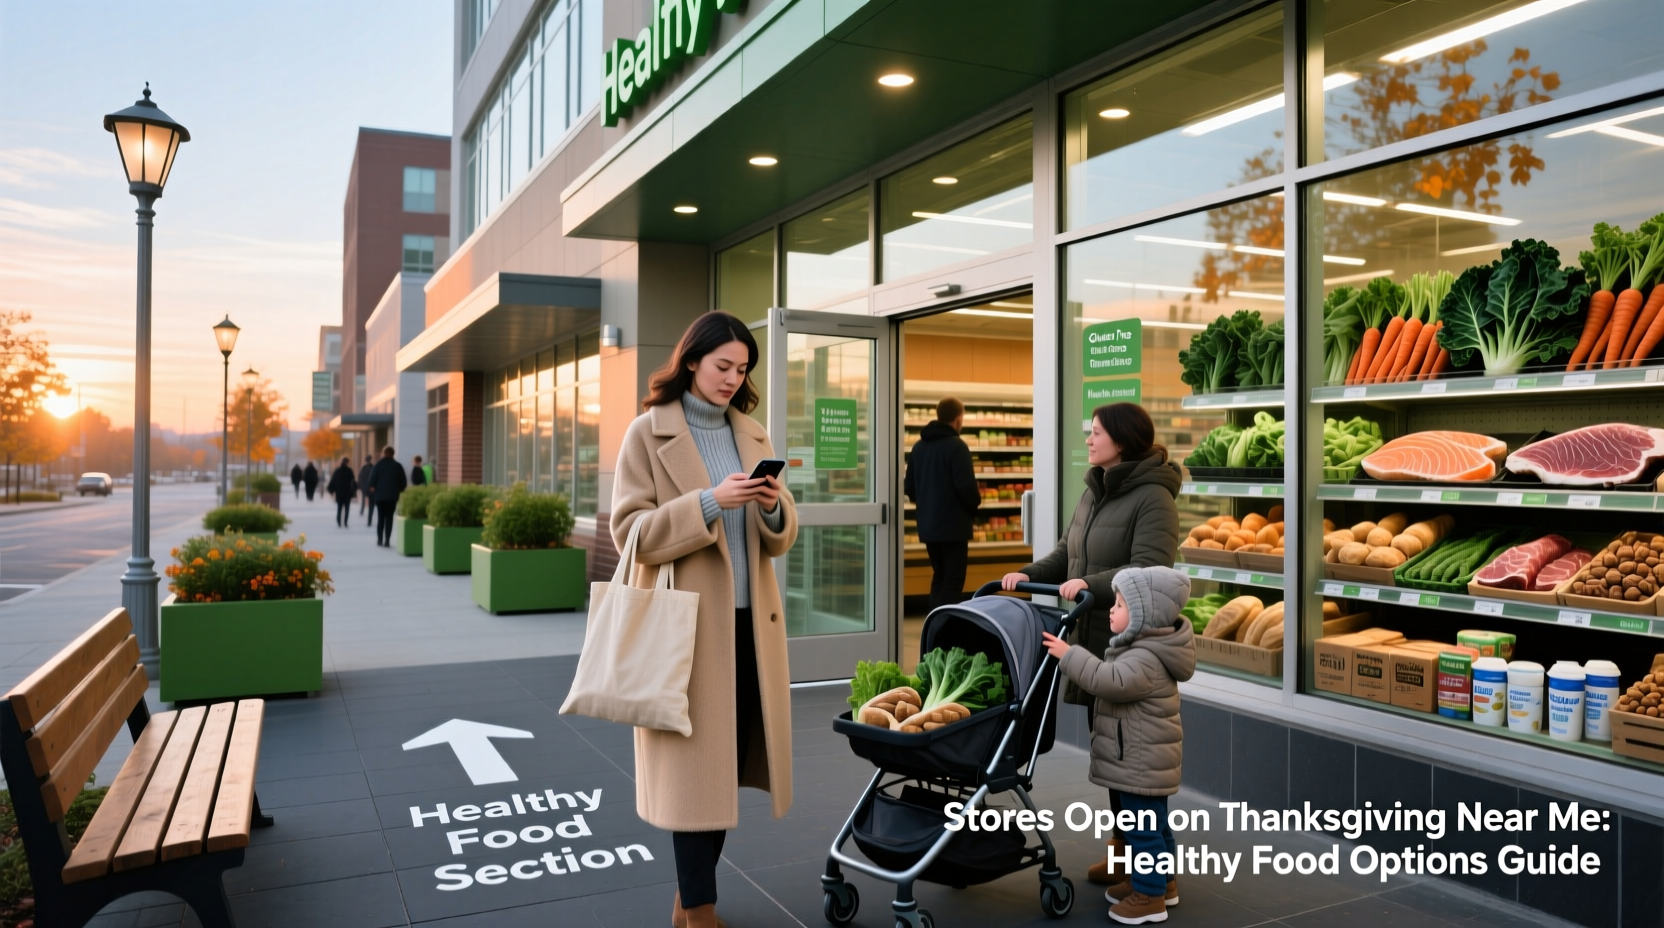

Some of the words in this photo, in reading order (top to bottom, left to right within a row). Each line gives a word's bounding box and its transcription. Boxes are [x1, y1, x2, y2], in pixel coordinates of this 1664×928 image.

[409, 788, 603, 828] Healthy
[446, 814, 593, 855] Food
[434, 843, 655, 891] Section
